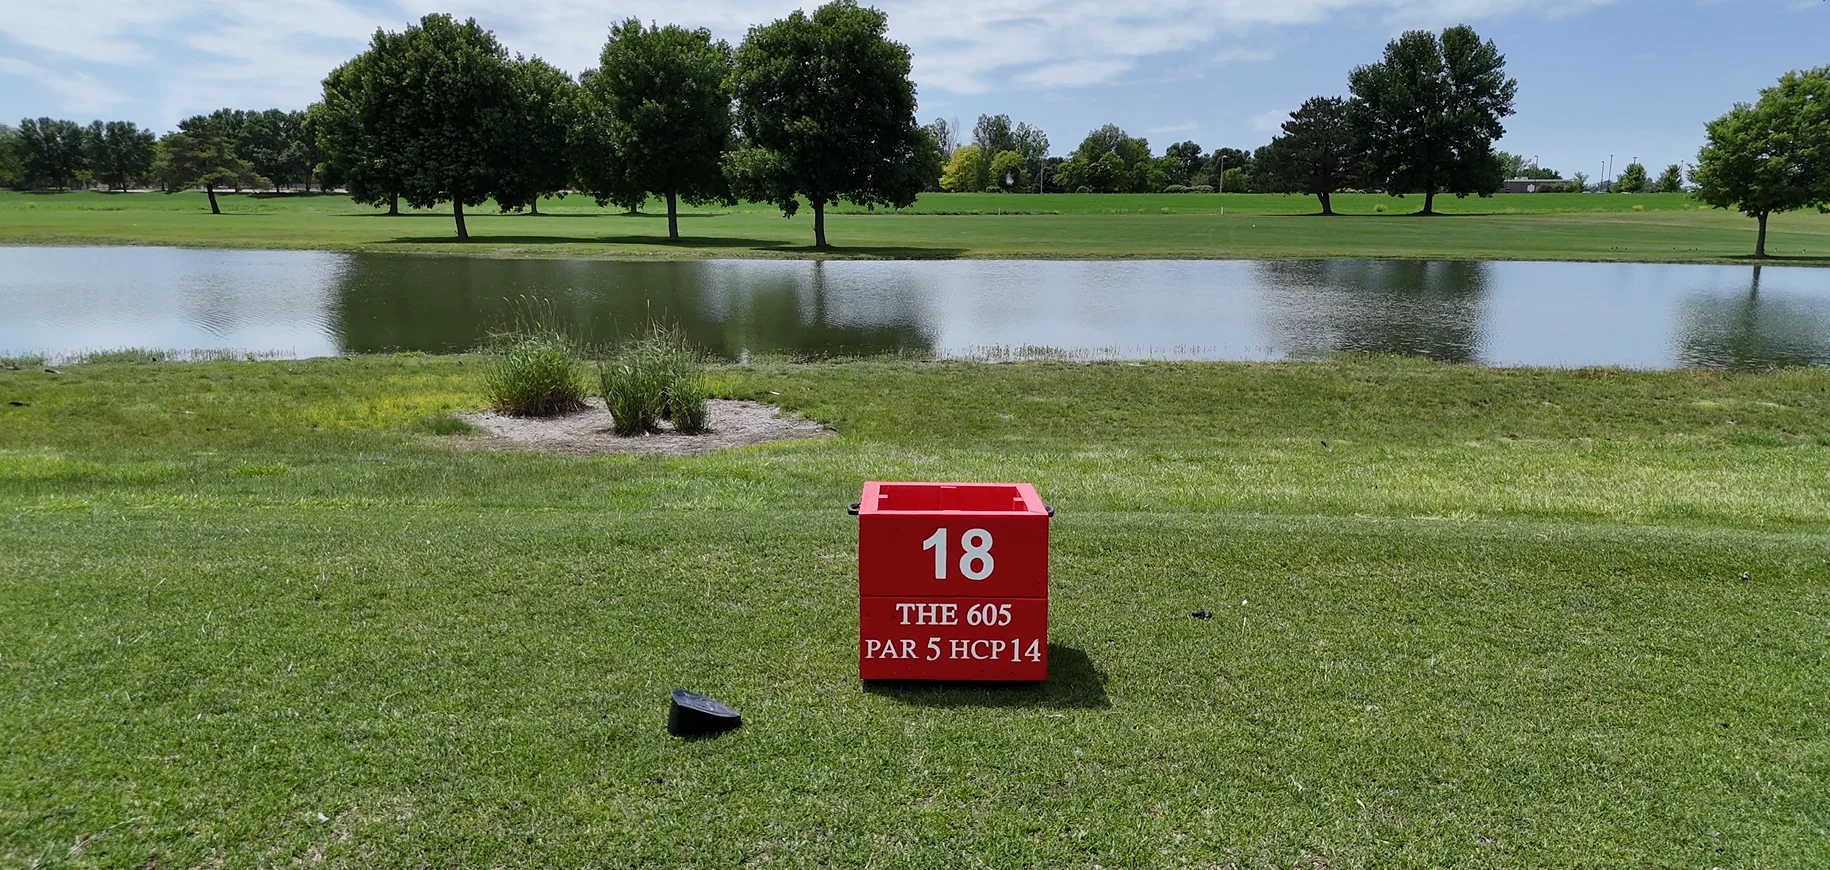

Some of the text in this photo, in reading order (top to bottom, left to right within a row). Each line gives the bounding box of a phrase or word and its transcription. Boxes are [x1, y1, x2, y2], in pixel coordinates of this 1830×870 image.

[922, 527, 995, 580] 18
[896, 603, 1012, 626] THE 605
[865, 637, 1041, 662] PAR 5 HCP 14
